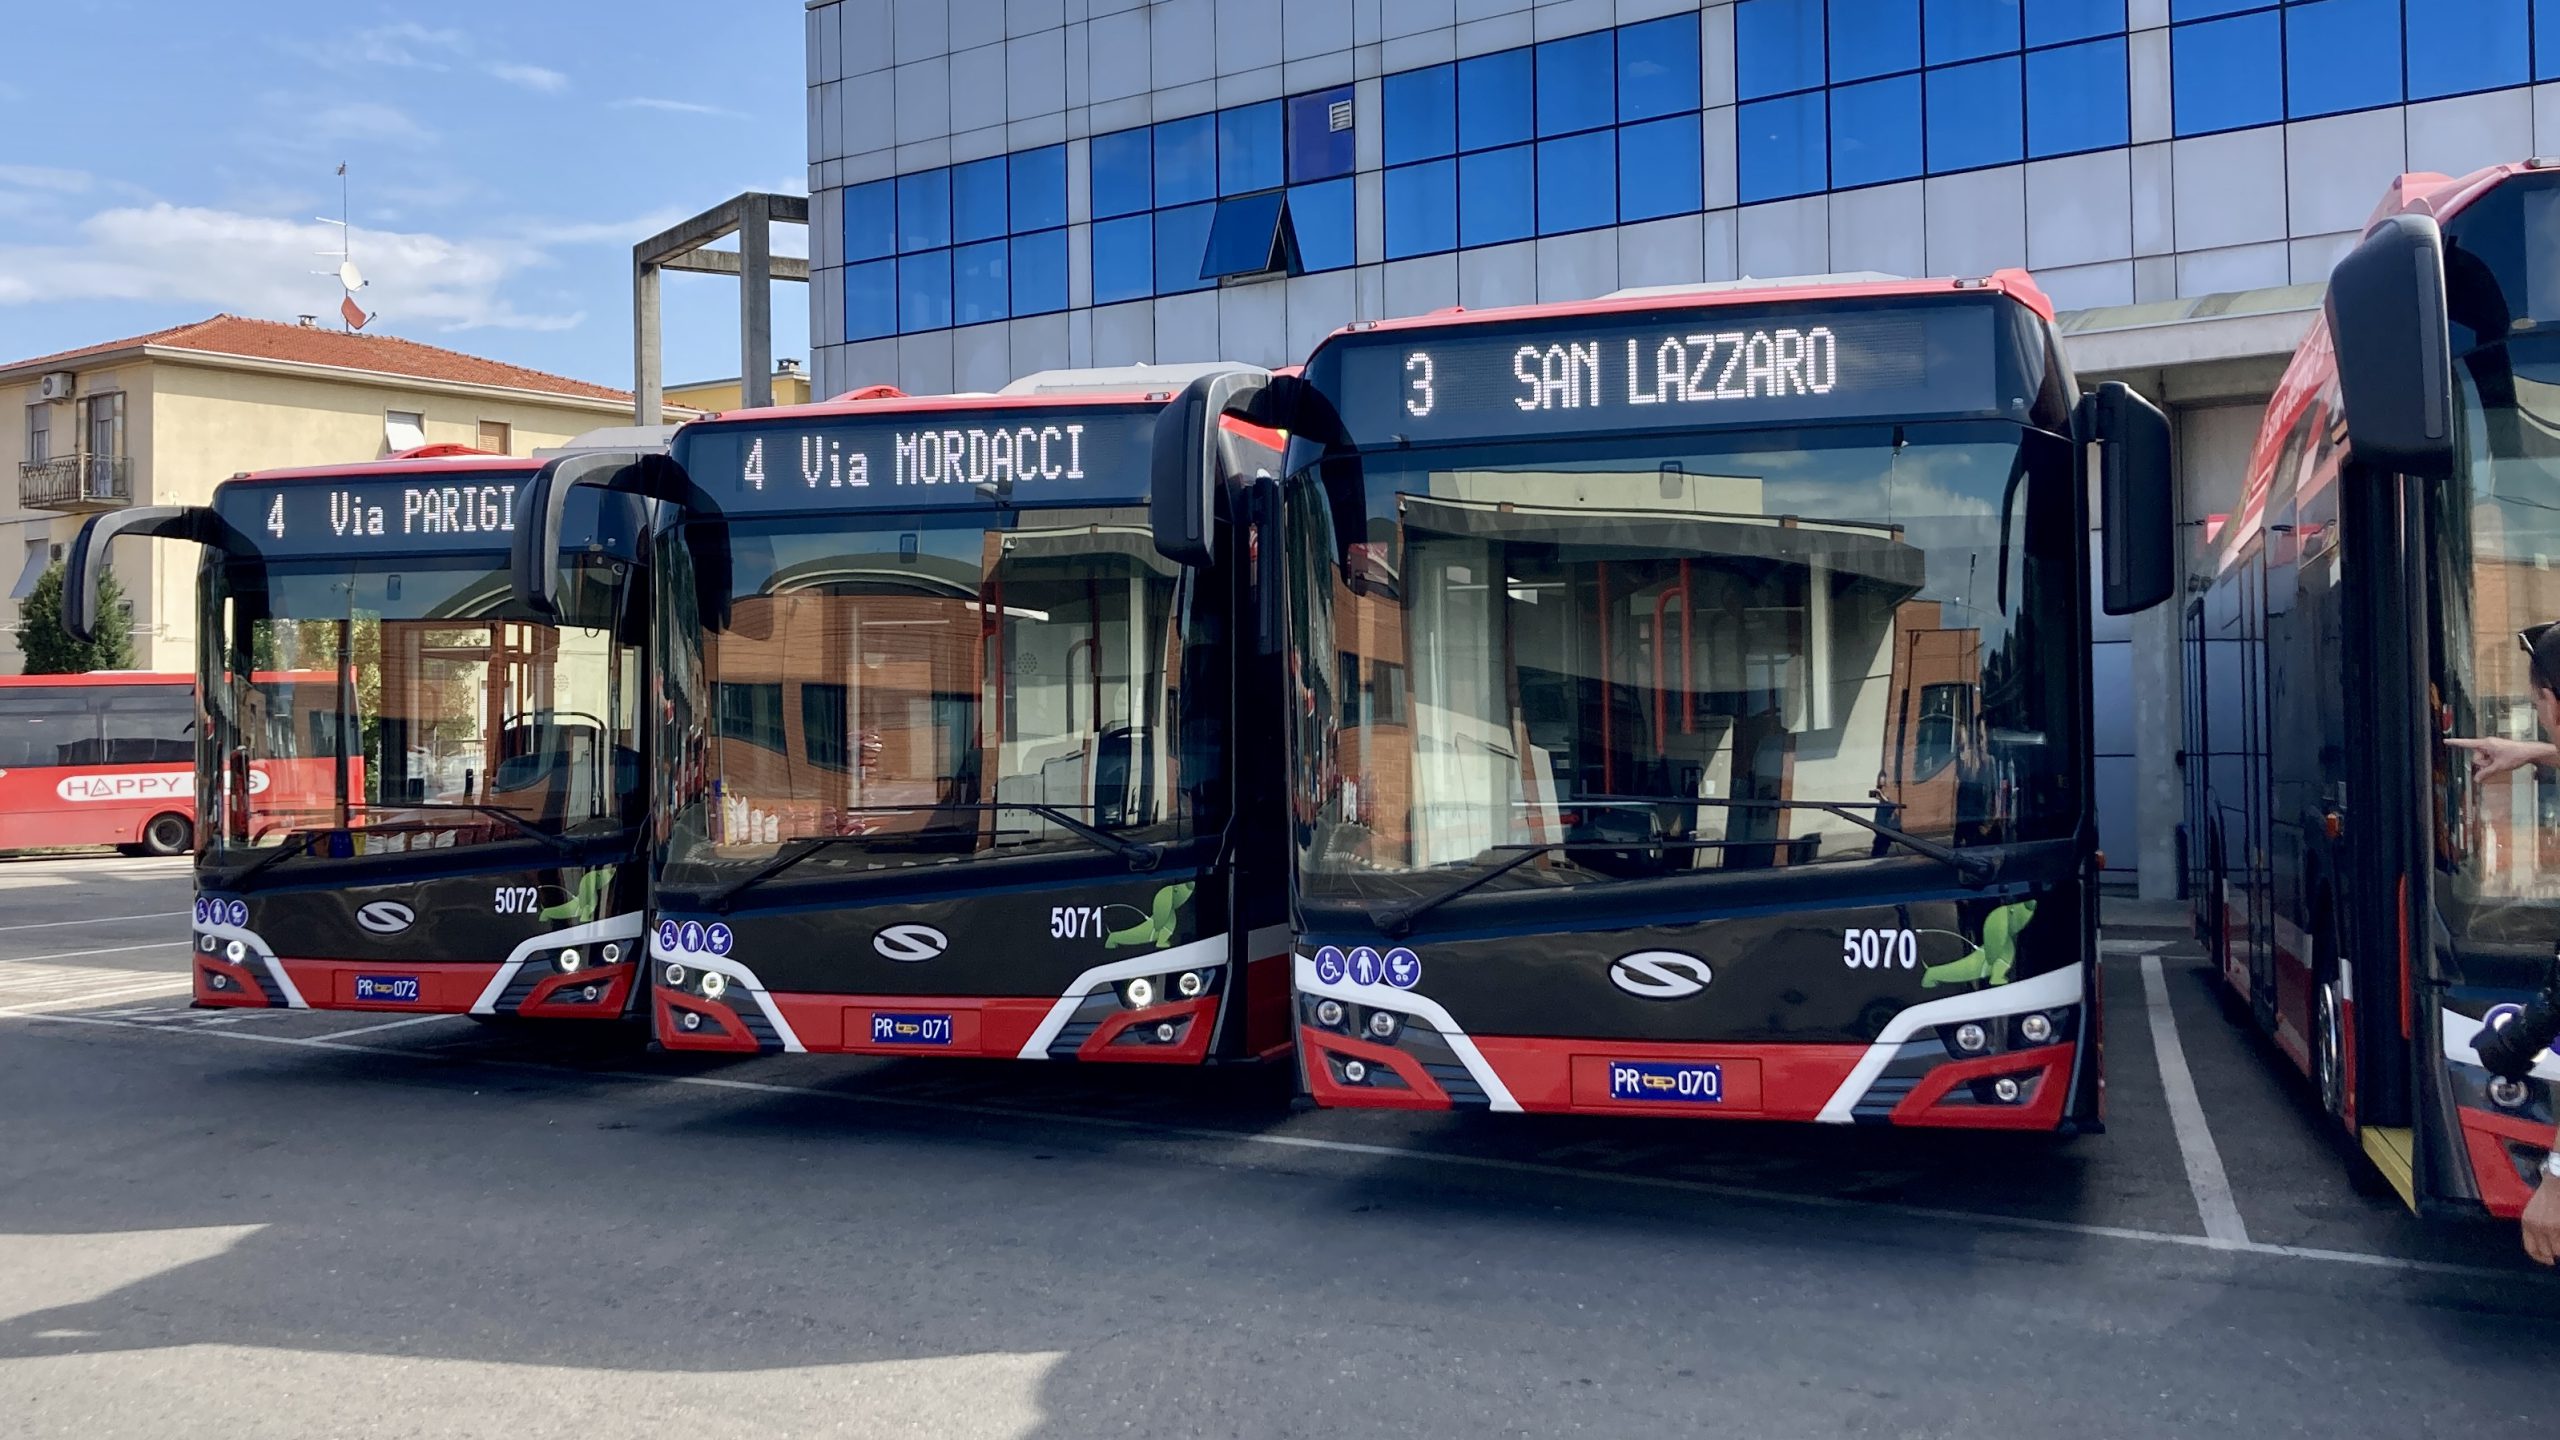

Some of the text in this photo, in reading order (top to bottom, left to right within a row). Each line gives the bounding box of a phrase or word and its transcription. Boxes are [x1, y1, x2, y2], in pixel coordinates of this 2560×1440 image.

[1406, 326, 1836, 417] 3 SAN LAZZARO
[744, 425, 1084, 490] 4 Via MORDACCI
[267, 485, 515, 539] 4 Via PARIGI
[67, 777, 180, 797] HAPPY
[495, 887, 538, 914] 5072
[1051, 907, 1102, 938] 5071
[1843, 929, 1917, 969] 5070
[357, 979, 374, 996] PR
[393, 980, 417, 998] 072
[874, 1018, 894, 1038] PR
[922, 1019, 949, 1039] 071
[1614, 1068, 1640, 1093] PR
[1678, 1070, 1717, 1096] 070
